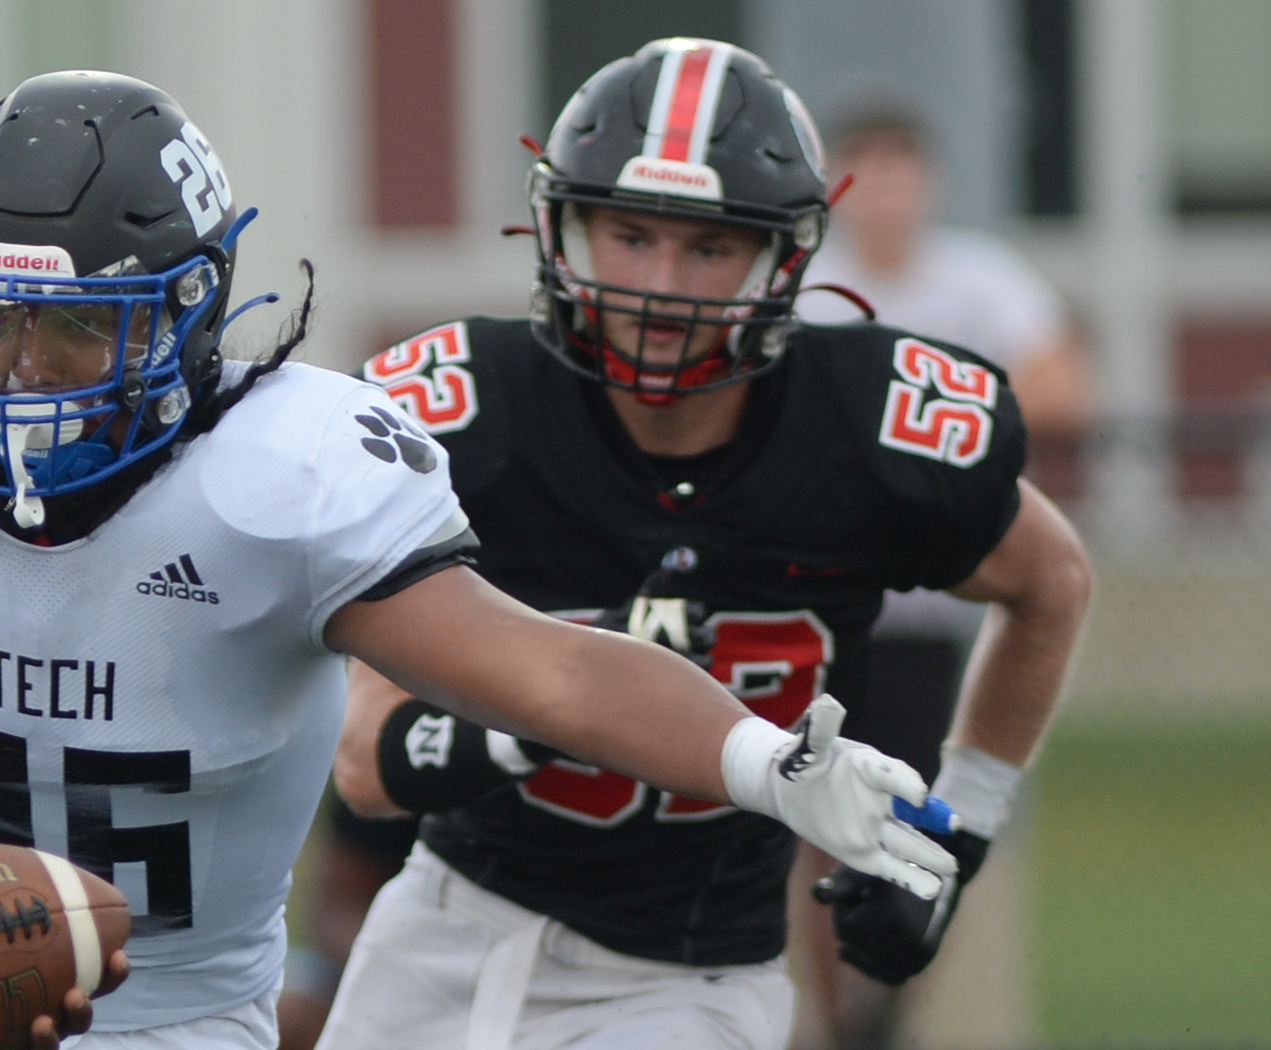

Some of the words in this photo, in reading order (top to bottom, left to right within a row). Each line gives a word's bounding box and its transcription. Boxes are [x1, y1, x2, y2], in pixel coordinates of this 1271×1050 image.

[159, 120, 233, 239] 26
[363, 320, 480, 436] 52
[877, 336, 999, 470] 52
[136, 578, 220, 605] adidas
